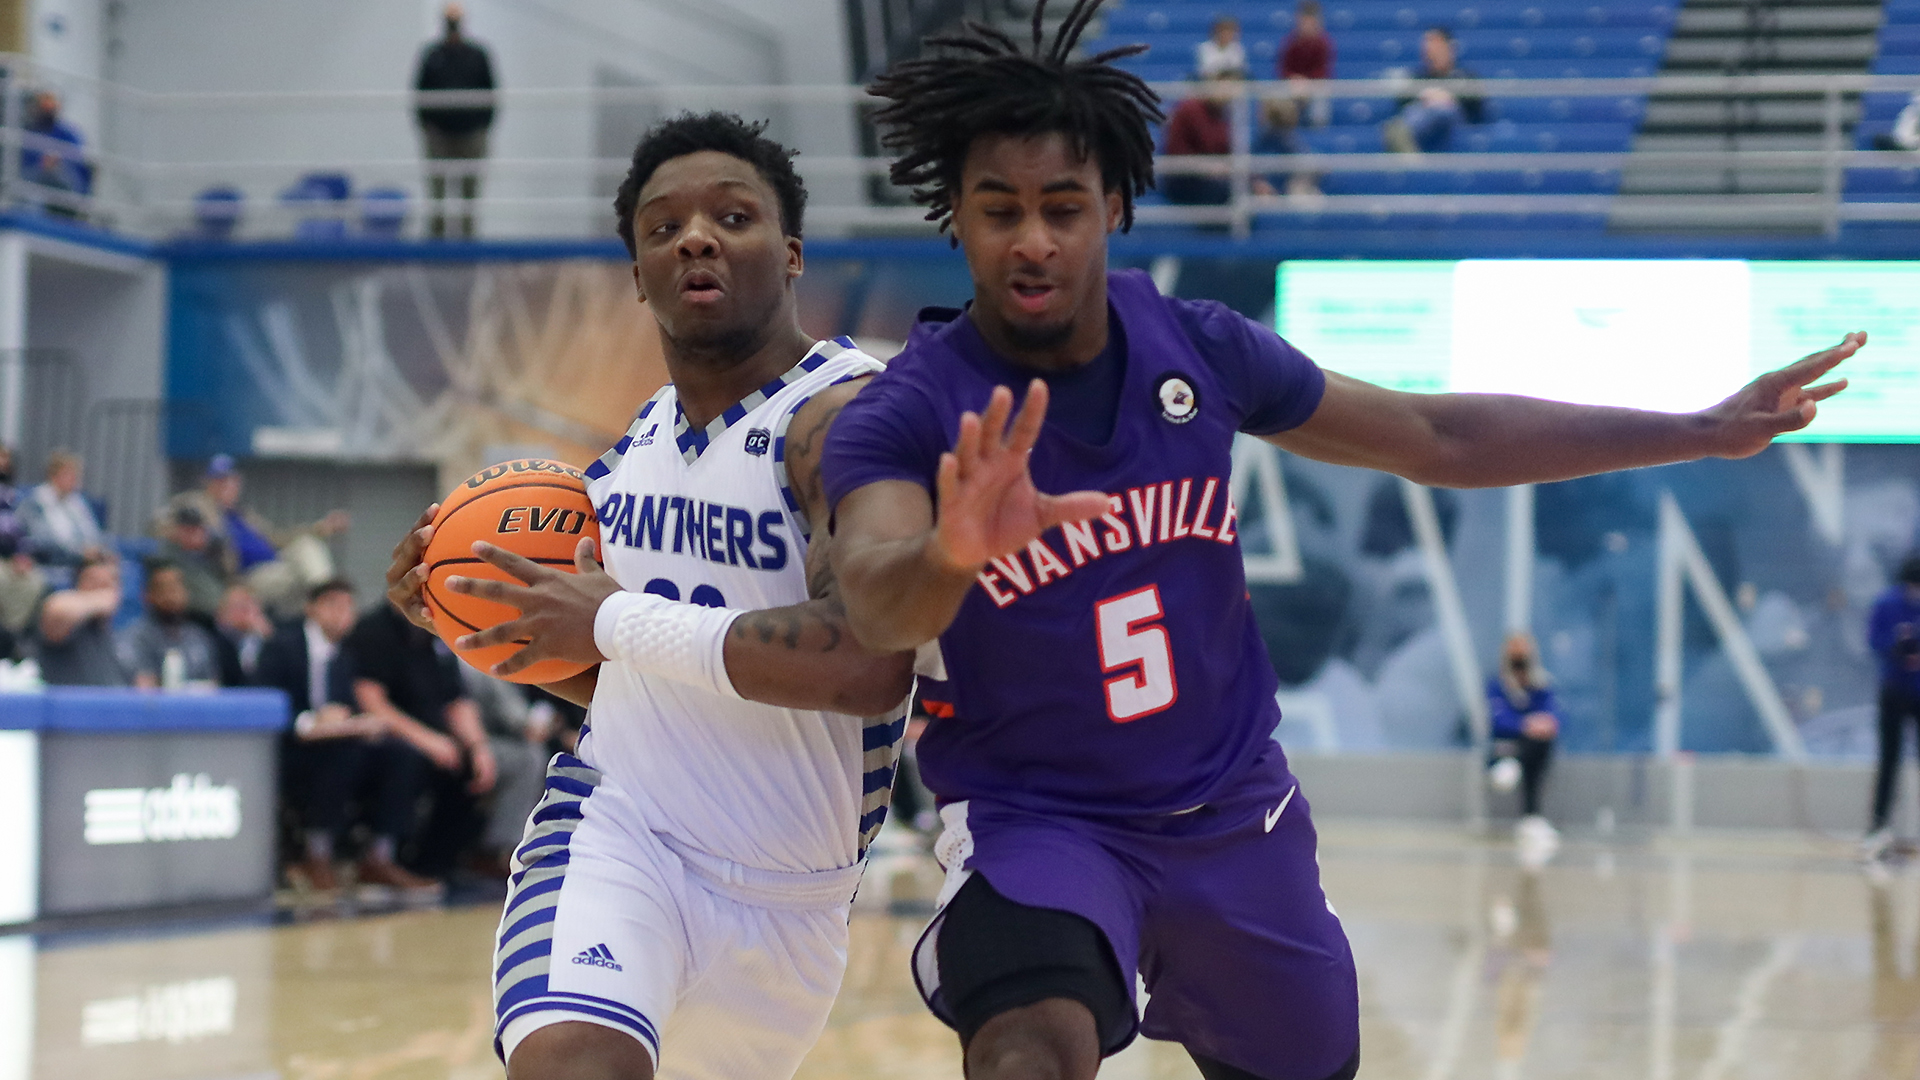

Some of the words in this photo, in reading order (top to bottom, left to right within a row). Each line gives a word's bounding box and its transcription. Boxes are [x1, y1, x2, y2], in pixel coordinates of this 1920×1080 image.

[596, 492, 788, 572] PANTHERS
[1094, 582, 1179, 724] 5
[571, 956, 623, 972] adidas
